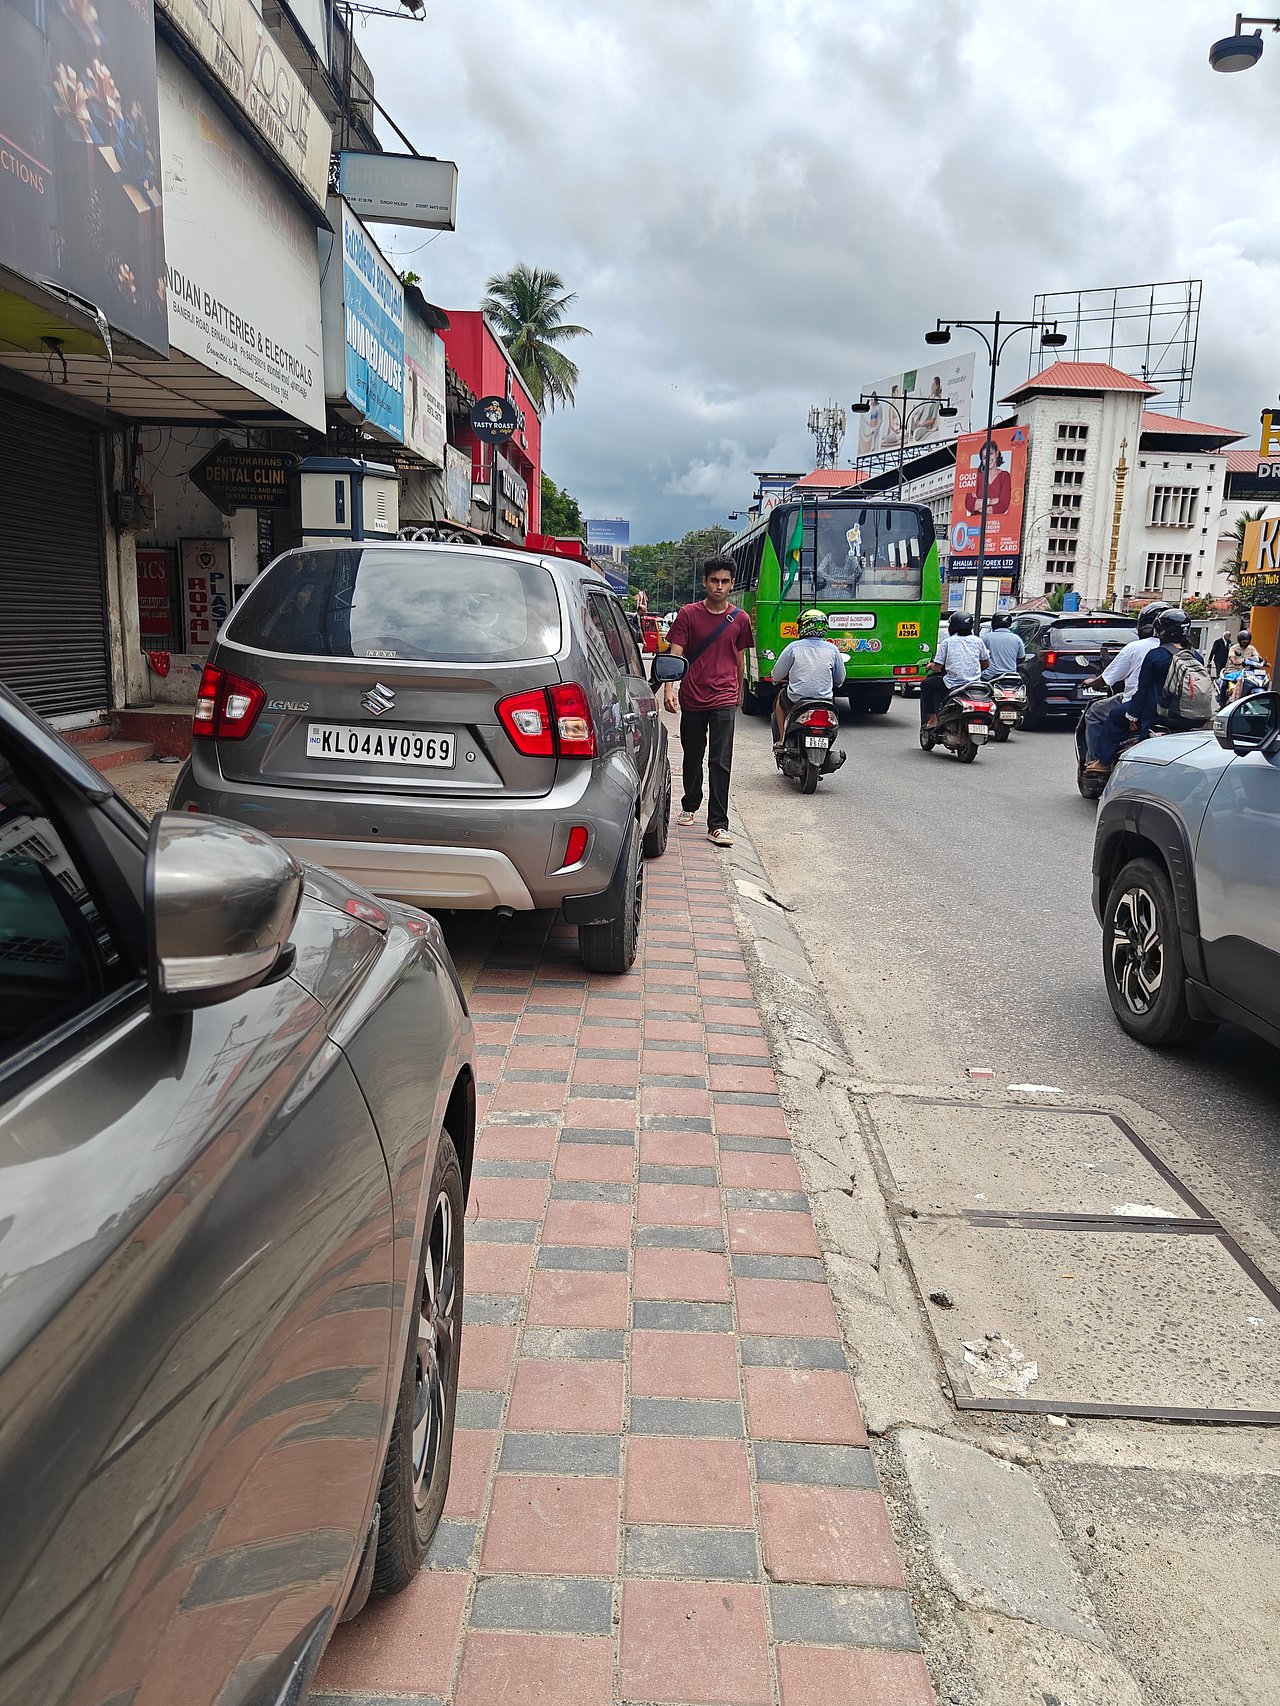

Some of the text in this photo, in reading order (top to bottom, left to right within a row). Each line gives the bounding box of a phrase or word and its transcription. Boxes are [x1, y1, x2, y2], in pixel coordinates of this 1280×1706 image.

[204, 292, 256, 349] BATTERIES
[257, 332, 264, 354] &
[265, 337, 313, 388] ELECTRICALS
[216, 455, 283, 468] KATTUKARANS
[206, 466, 288, 485] DENTAL CLINI
[959, 473, 977, 481] GOLD
[1241, 573, 1280, 587] Dates Nuts
[187, 577, 210, 645] ROYAL
[267, 699, 310, 712] IGNIS
[321, 730, 450, 761] KL04AV0969
